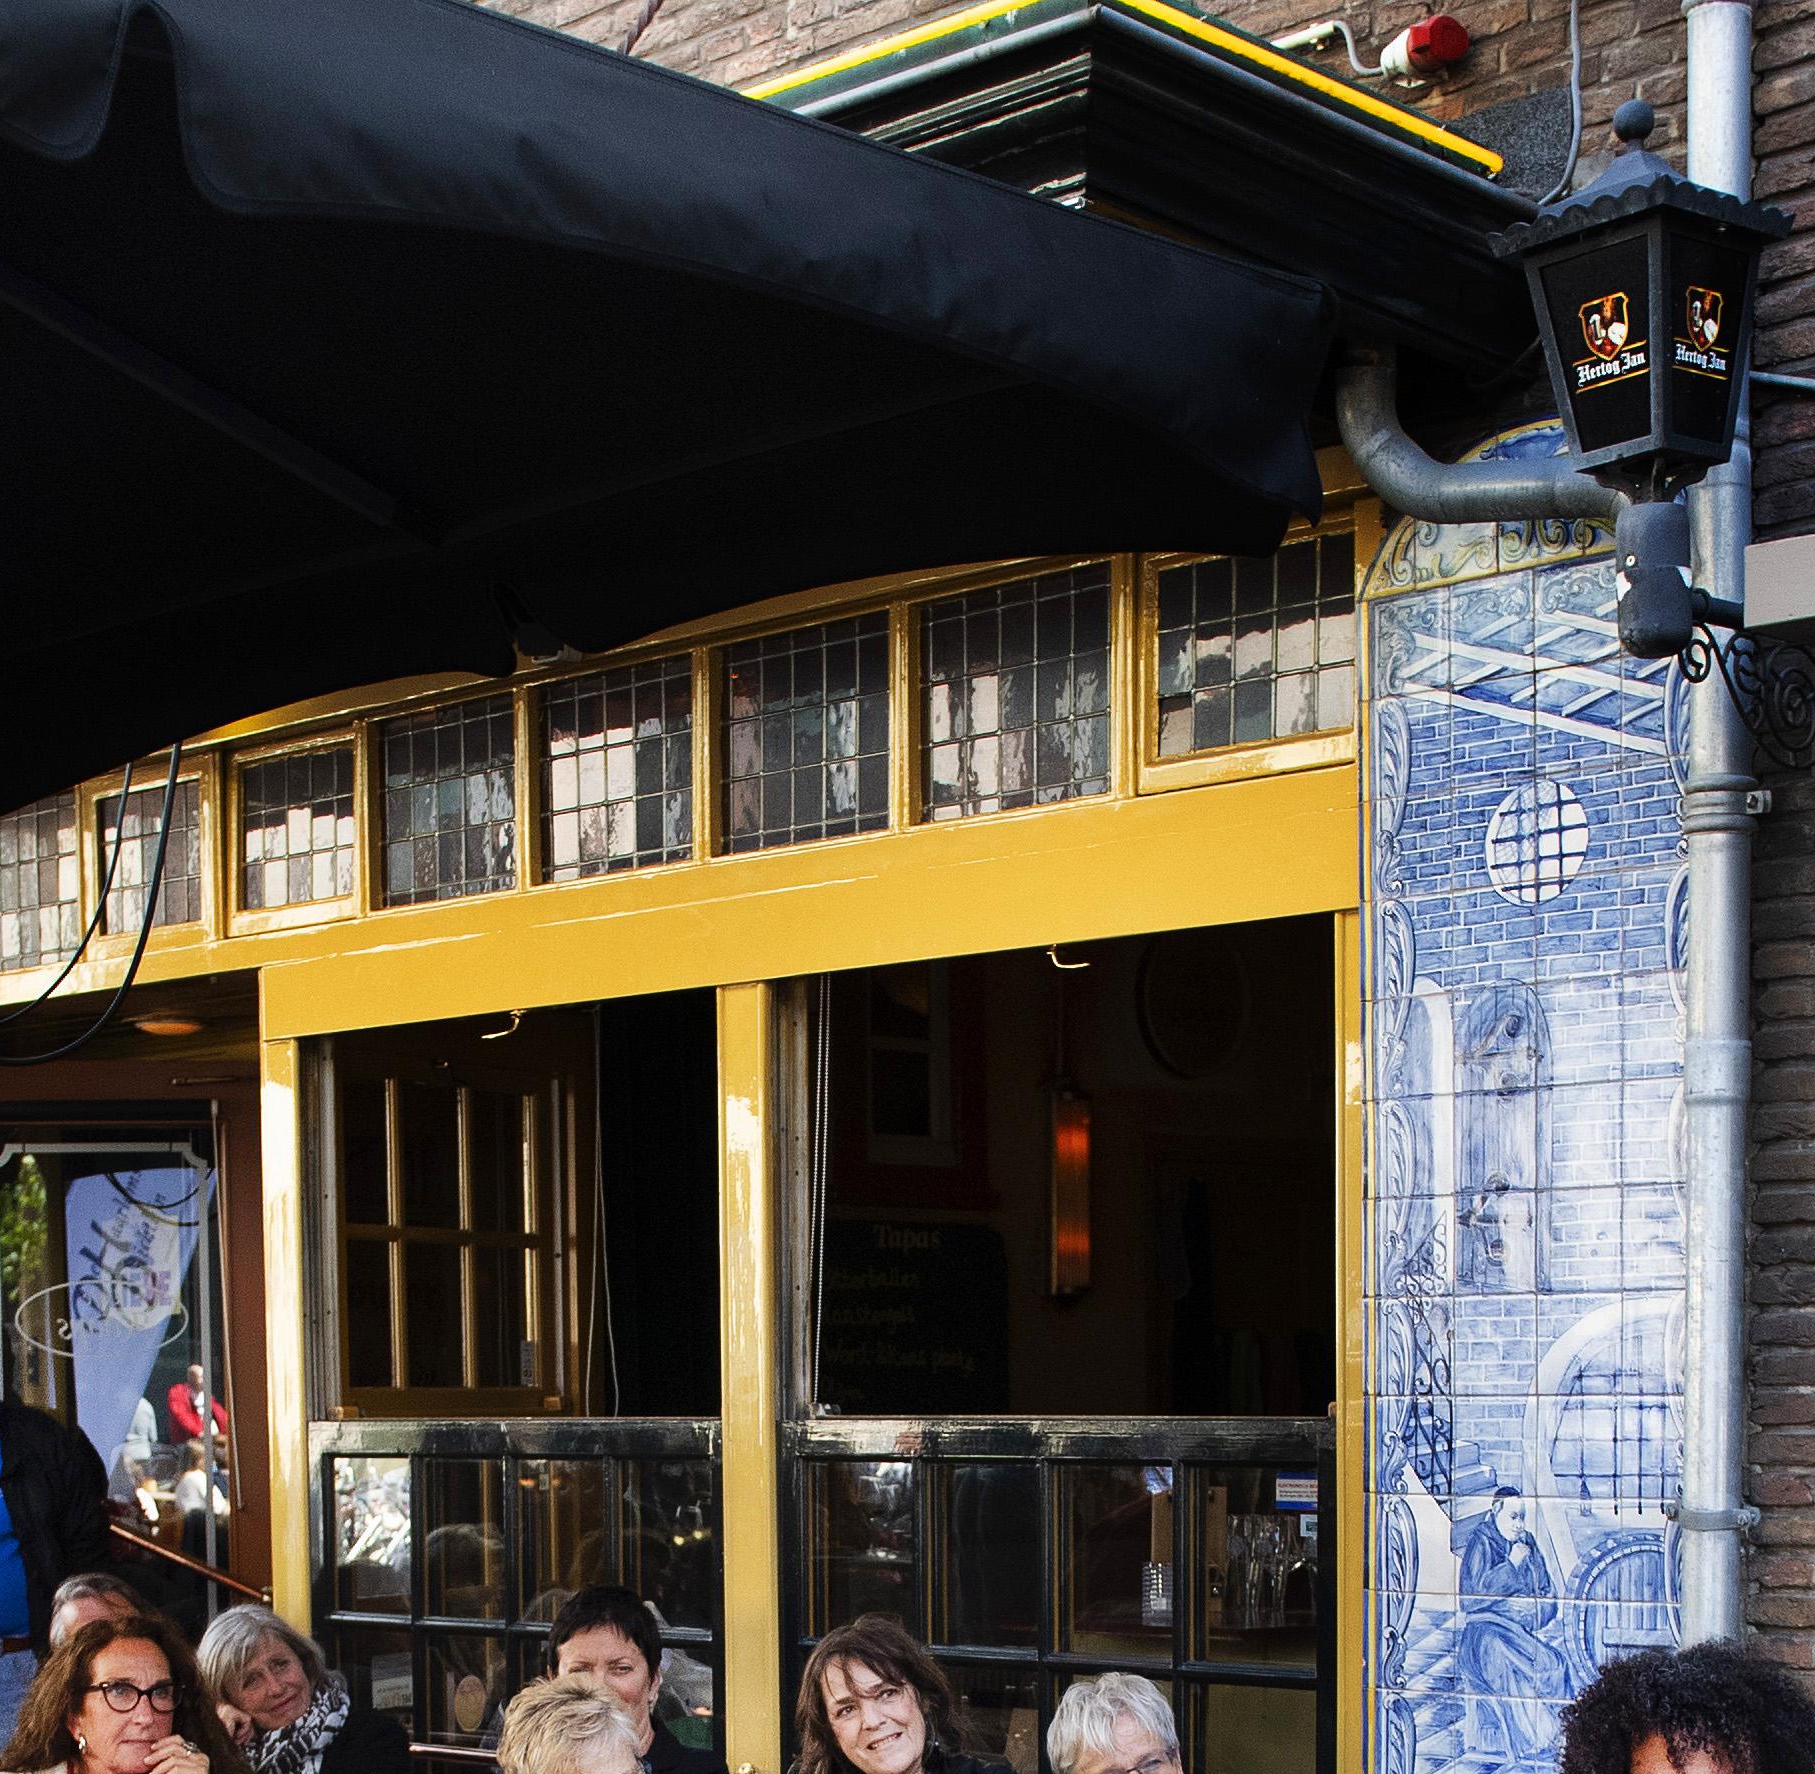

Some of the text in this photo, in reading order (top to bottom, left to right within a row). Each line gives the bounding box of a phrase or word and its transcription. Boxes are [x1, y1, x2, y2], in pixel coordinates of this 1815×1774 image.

[1577, 352, 1646, 387] Hertog Jan
[1675, 344, 1727, 372] Hertog Jan
